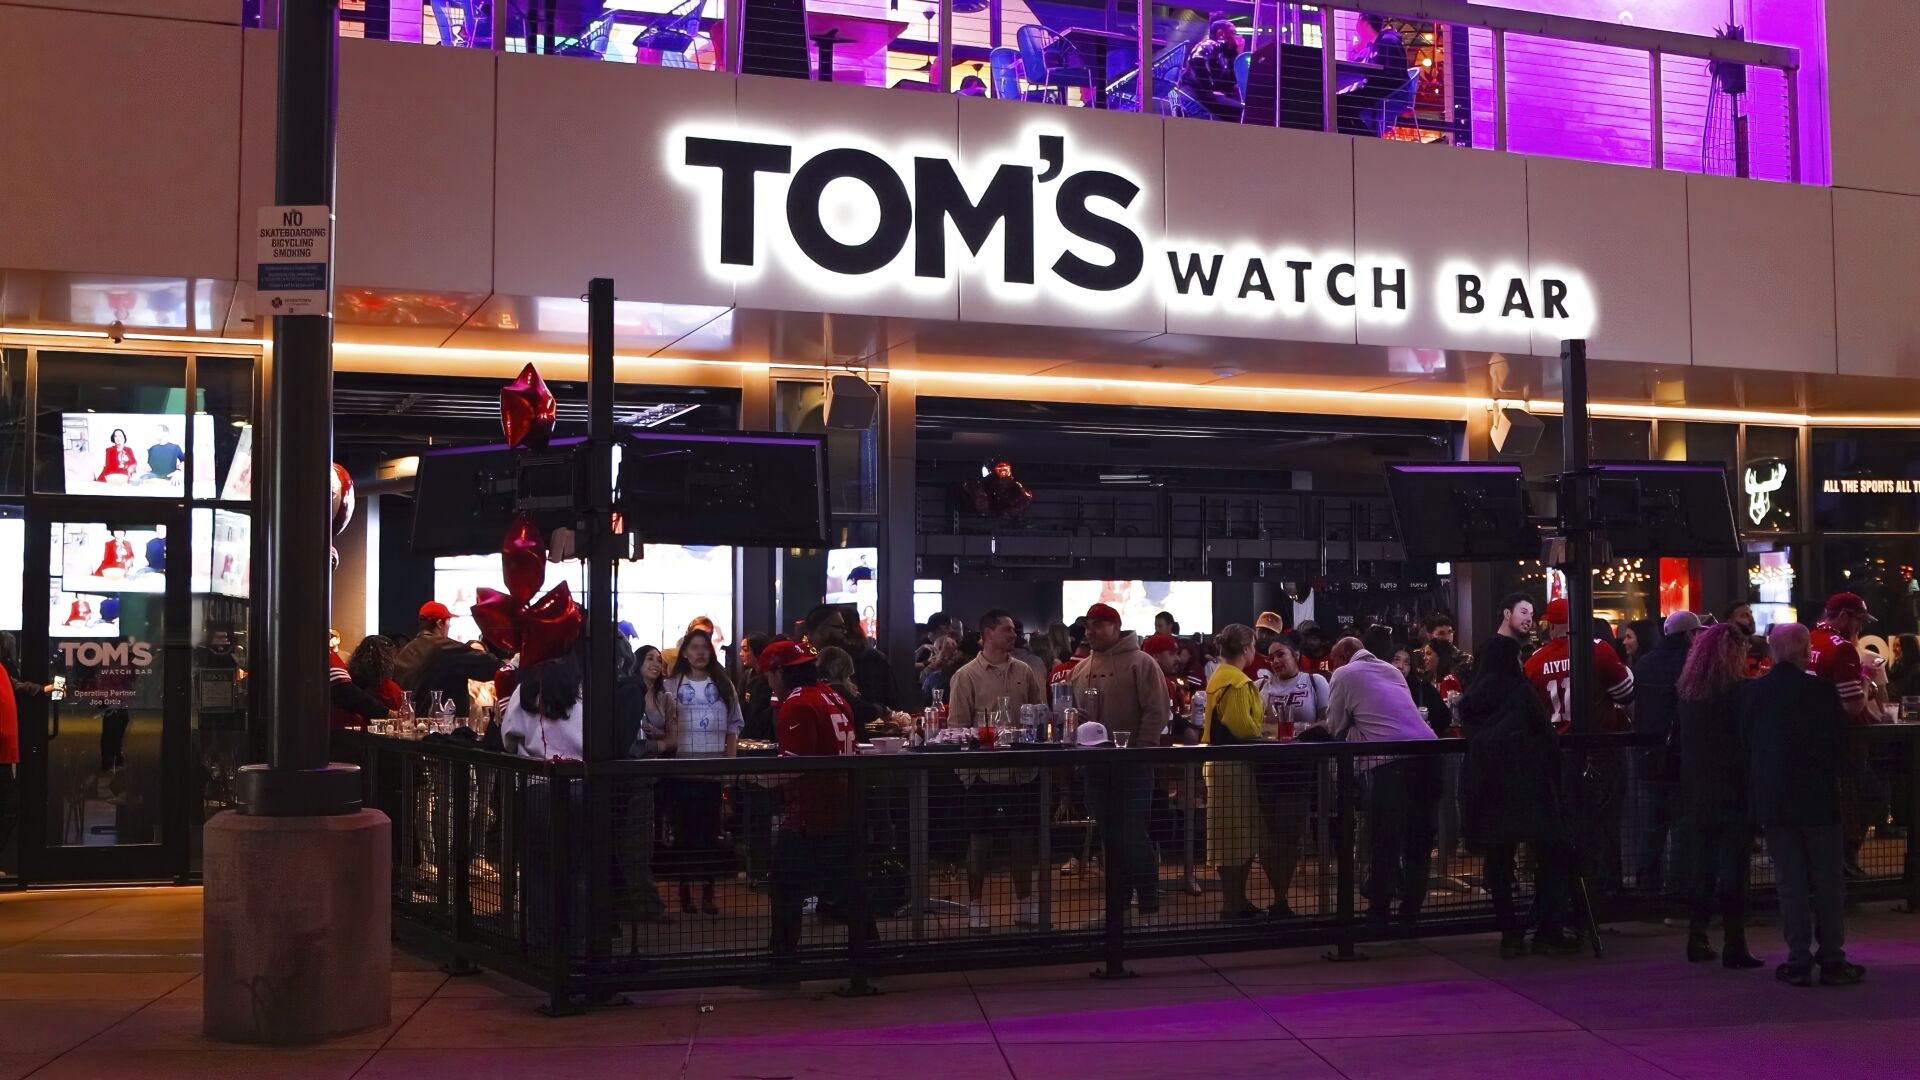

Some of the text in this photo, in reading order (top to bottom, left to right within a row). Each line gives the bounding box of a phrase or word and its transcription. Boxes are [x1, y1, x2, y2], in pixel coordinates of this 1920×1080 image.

[283, 211, 303, 227] NO
[685, 135, 1145, 291] TOM'S
[260, 228, 326, 238] SKATEBOARDING
[271, 238, 314, 248] BICYCLING
[273, 248, 311, 258] SMOKING
[1166, 250, 1570, 319] WATCH BAR
[1823, 479, 1840, 493] ALL
[1840, 479, 1859, 493] THE
[1860, 480, 1895, 493] SPORTS
[1895, 480, 1912, 493] ALL
[58, 635, 153, 667] TOM'S
[74, 689, 136, 700] Operating Partner
